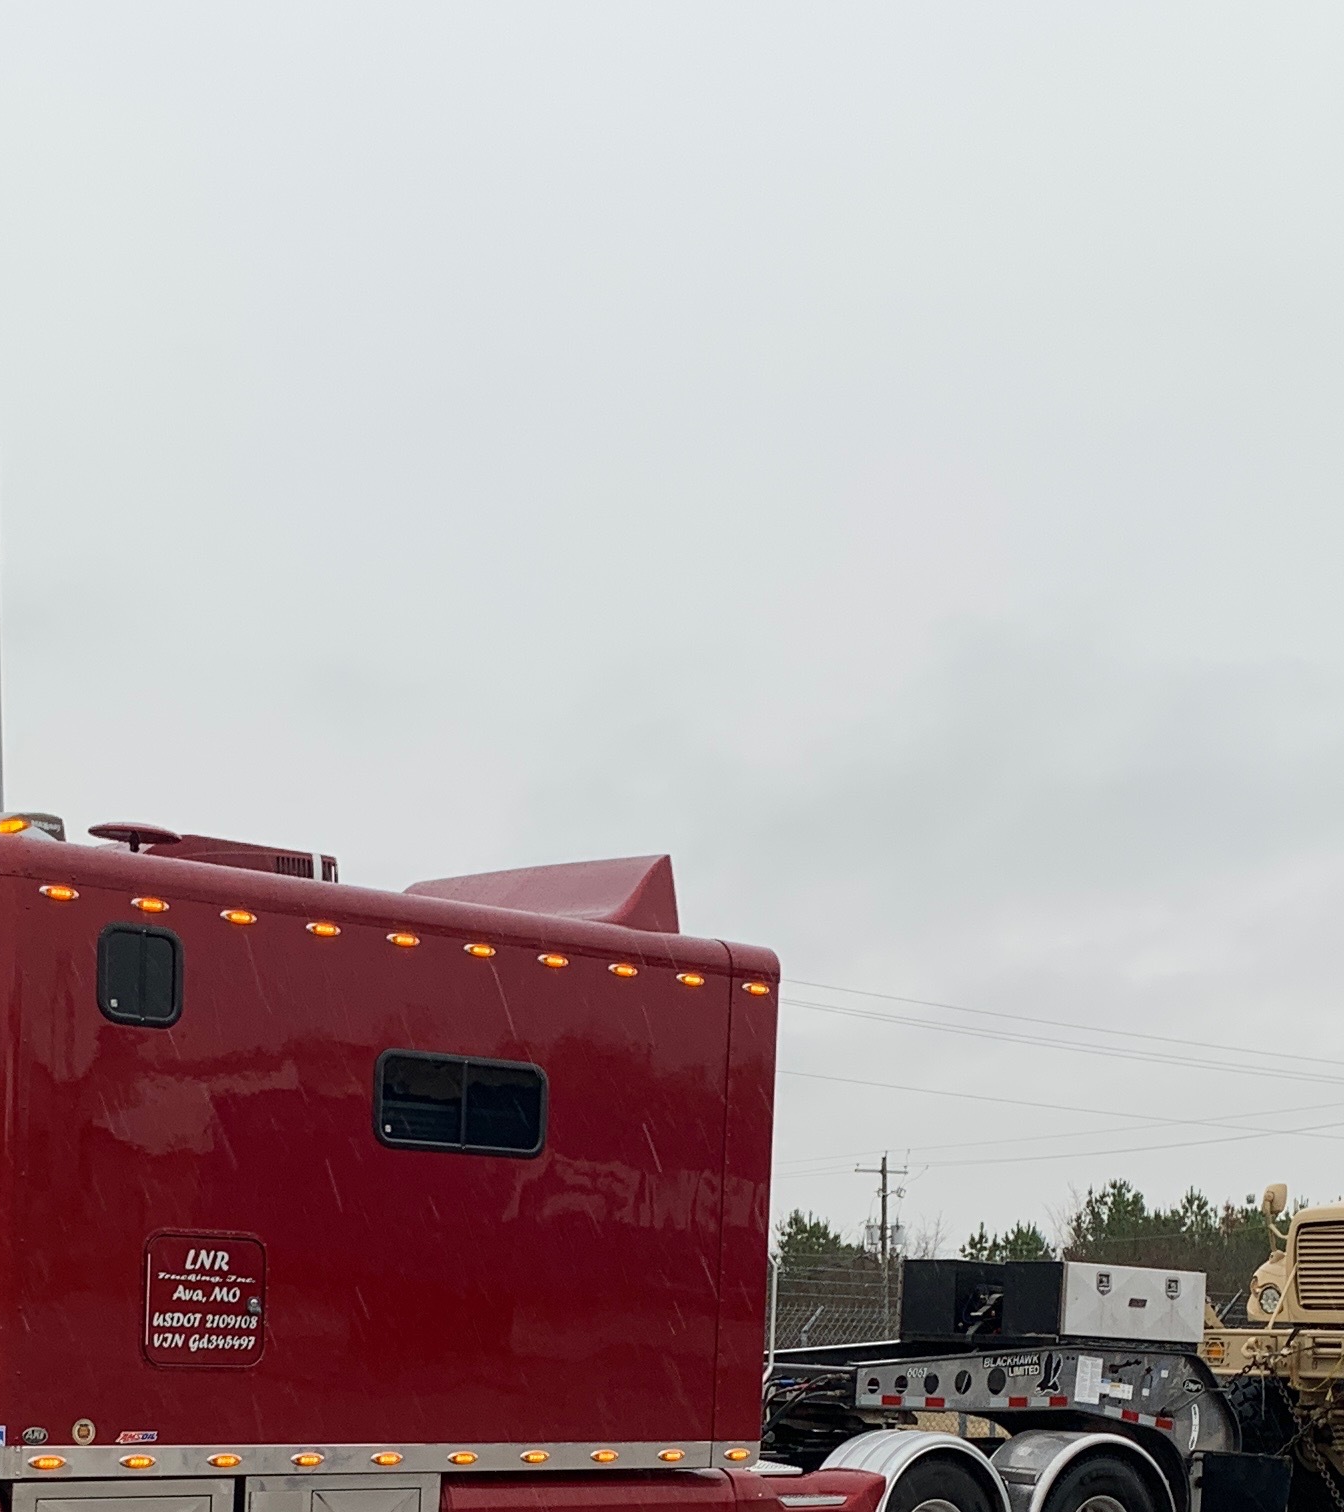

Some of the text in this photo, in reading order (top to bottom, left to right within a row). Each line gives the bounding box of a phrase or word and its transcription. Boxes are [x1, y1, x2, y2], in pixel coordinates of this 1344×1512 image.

[185, 1249, 229, 1271] LNR
[158, 1272, 256, 1283] Trucking, Inc.
[172, 1285, 240, 1303] Ava, MO
[152, 1312, 258, 1330] USDOT 2109108
[983, 1354, 1039, 1368] BLACKHAWK
[907, 1367, 928, 1378] 6061
[1008, 1365, 1040, 1377] LIMITED
[119, 1432, 156, 1442] AMSOIL
